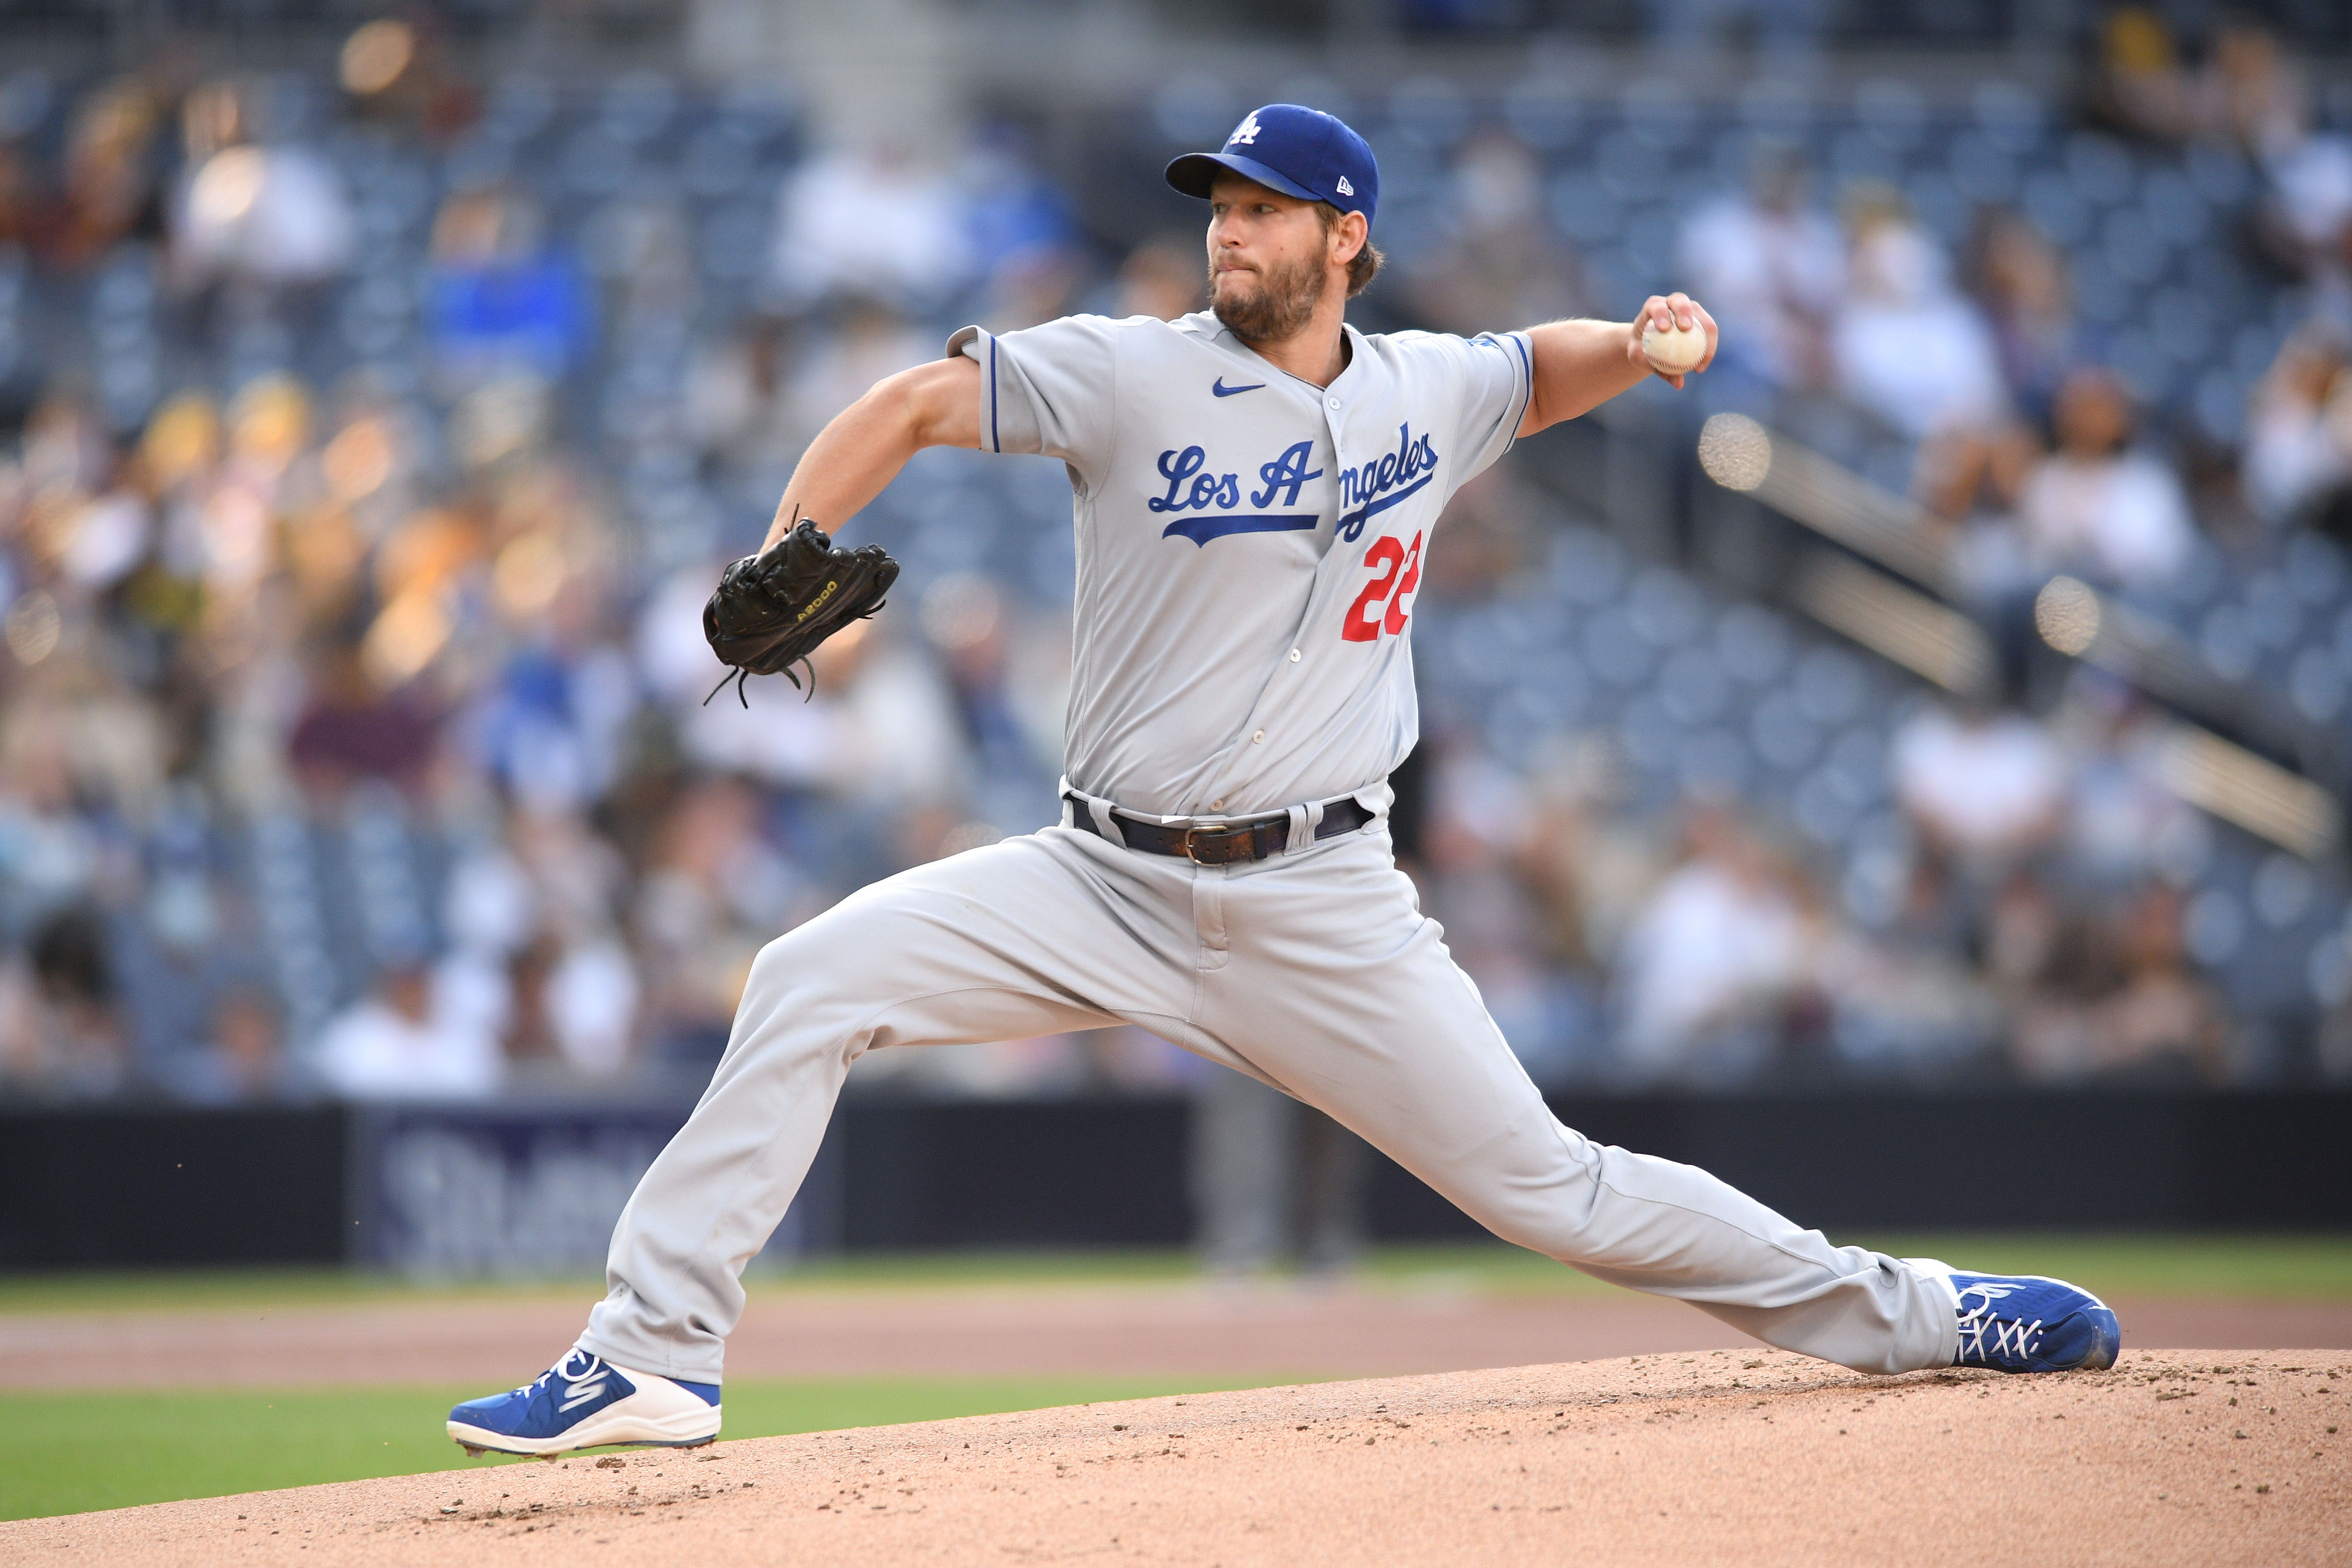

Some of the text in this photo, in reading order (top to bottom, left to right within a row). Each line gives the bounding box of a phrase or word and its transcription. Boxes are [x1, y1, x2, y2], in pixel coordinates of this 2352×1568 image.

[1229, 110, 1262, 145] LA
[1148, 445, 1240, 512] Los
[797, 581, 838, 622] A2000
[1341, 529, 1419, 642] 22
